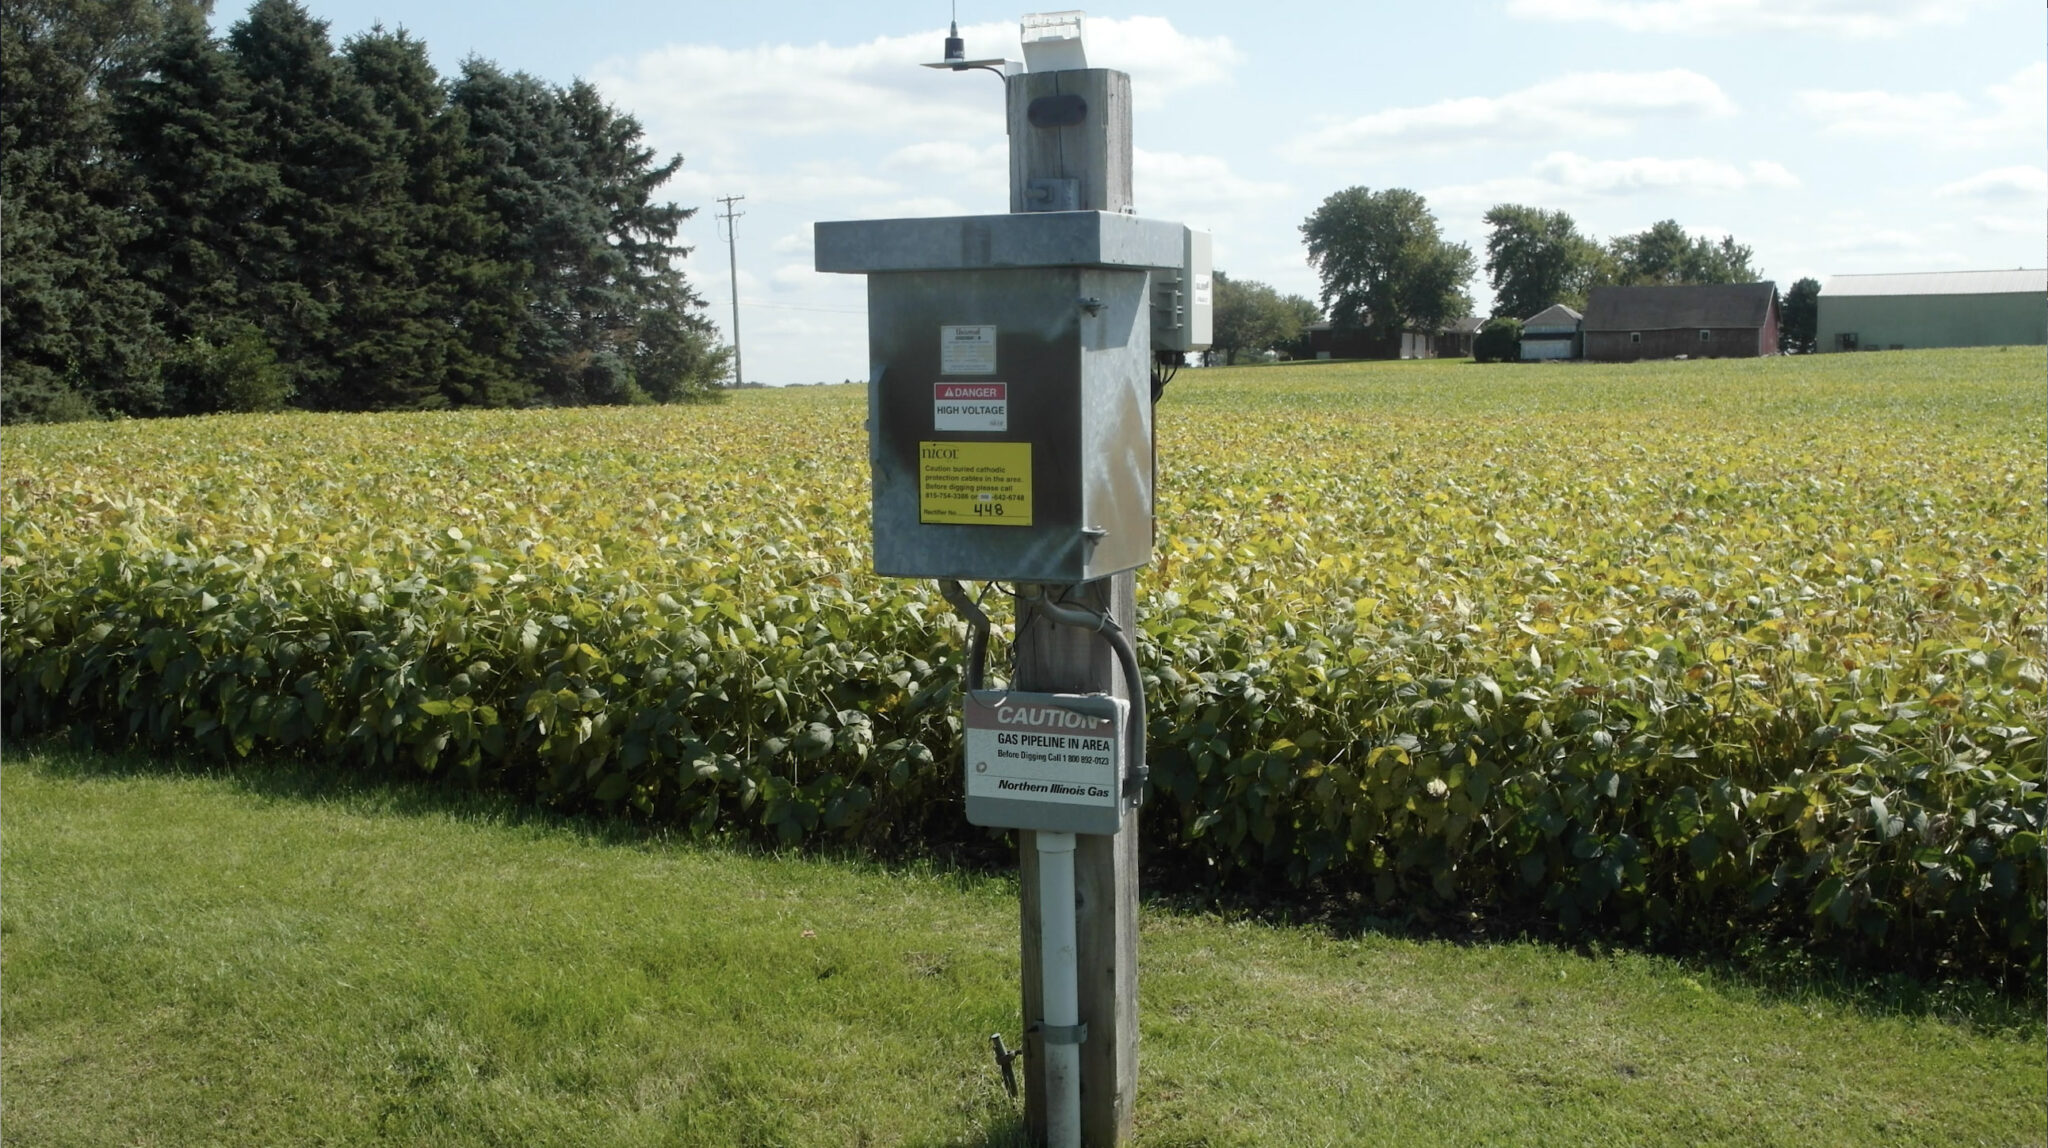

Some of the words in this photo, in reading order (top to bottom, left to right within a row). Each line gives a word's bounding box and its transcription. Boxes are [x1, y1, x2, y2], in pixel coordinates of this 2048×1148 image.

[955, 387, 997, 398] DANGER
[937, 406, 960, 415] HIGH
[961, 406, 1005, 415] VOLTAGE
[949, 483, 975, 492] digging
[974, 503, 1004, 517] 448
[997, 706, 1100, 730] CAUTION
[997, 733, 1018, 746] GAS
[1021, 735, 1065, 749] PIPELINE
[1068, 738, 1079, 750] IN
[1082, 740, 1110, 752] AREA
[997, 749, 1020, 759] Before
[1020, 752, 1047, 762] Digging
[1048, 753, 1061, 762] Call
[1068, 755, 1079, 763] 800
[998, 779, 1048, 793] Northern
[1050, 783, 1085, 796] Illinois
[1088, 786, 1109, 798] Gas
